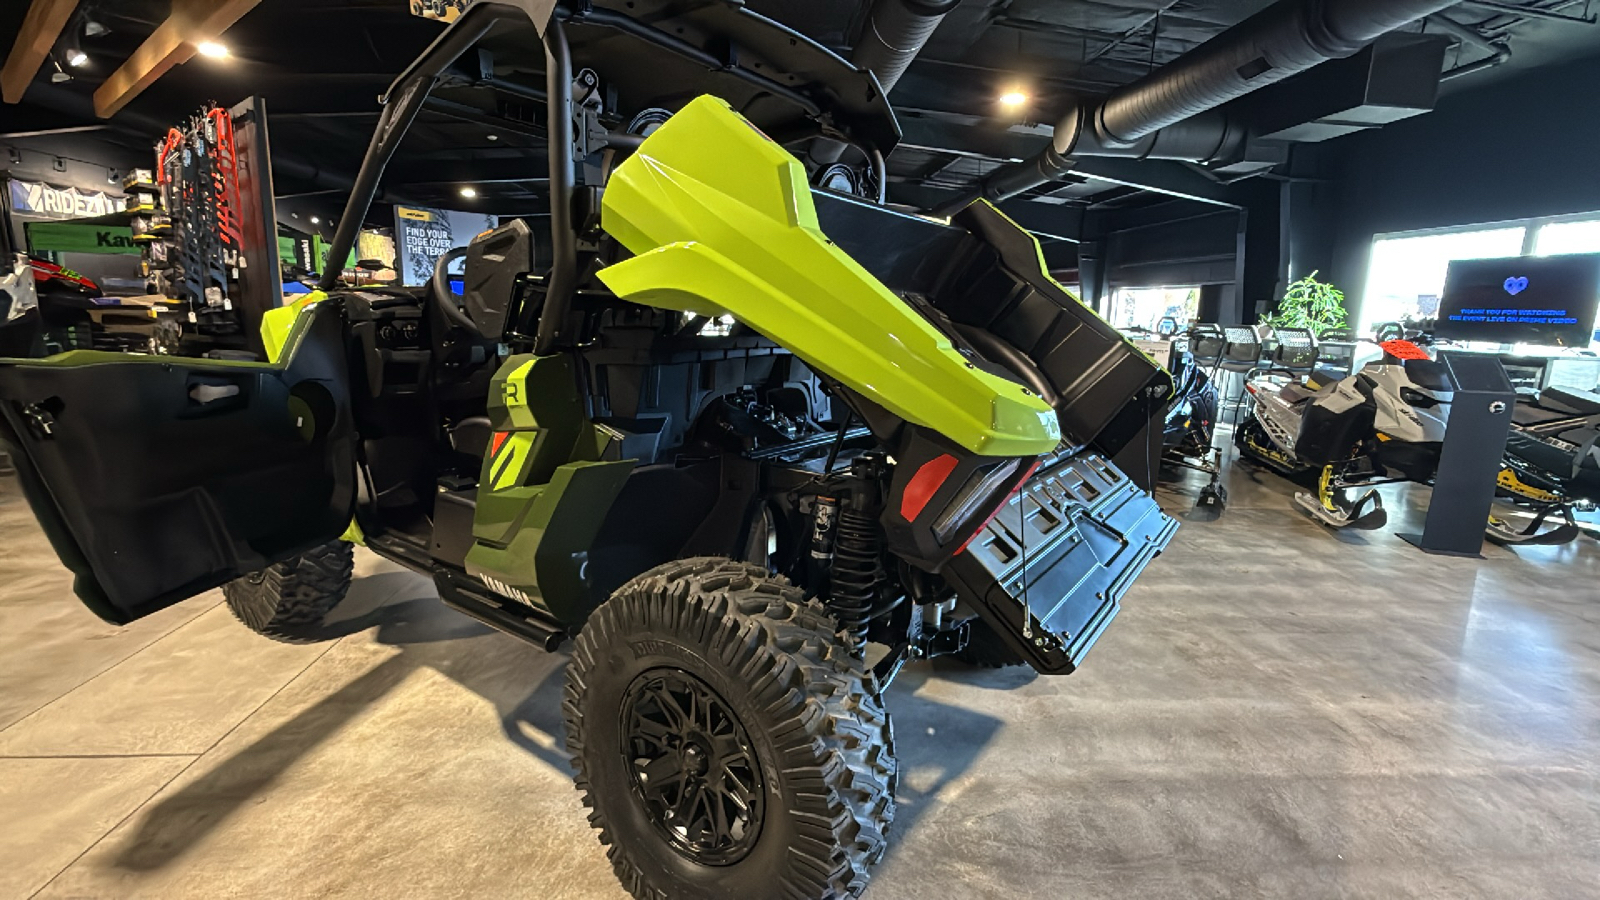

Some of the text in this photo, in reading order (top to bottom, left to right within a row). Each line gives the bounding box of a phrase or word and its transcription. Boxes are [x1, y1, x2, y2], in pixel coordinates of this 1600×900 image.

[406, 226, 448, 239] FIND YOUR
[406, 236, 451, 249] EDGE OVER
[406, 244, 423, 254] THE
